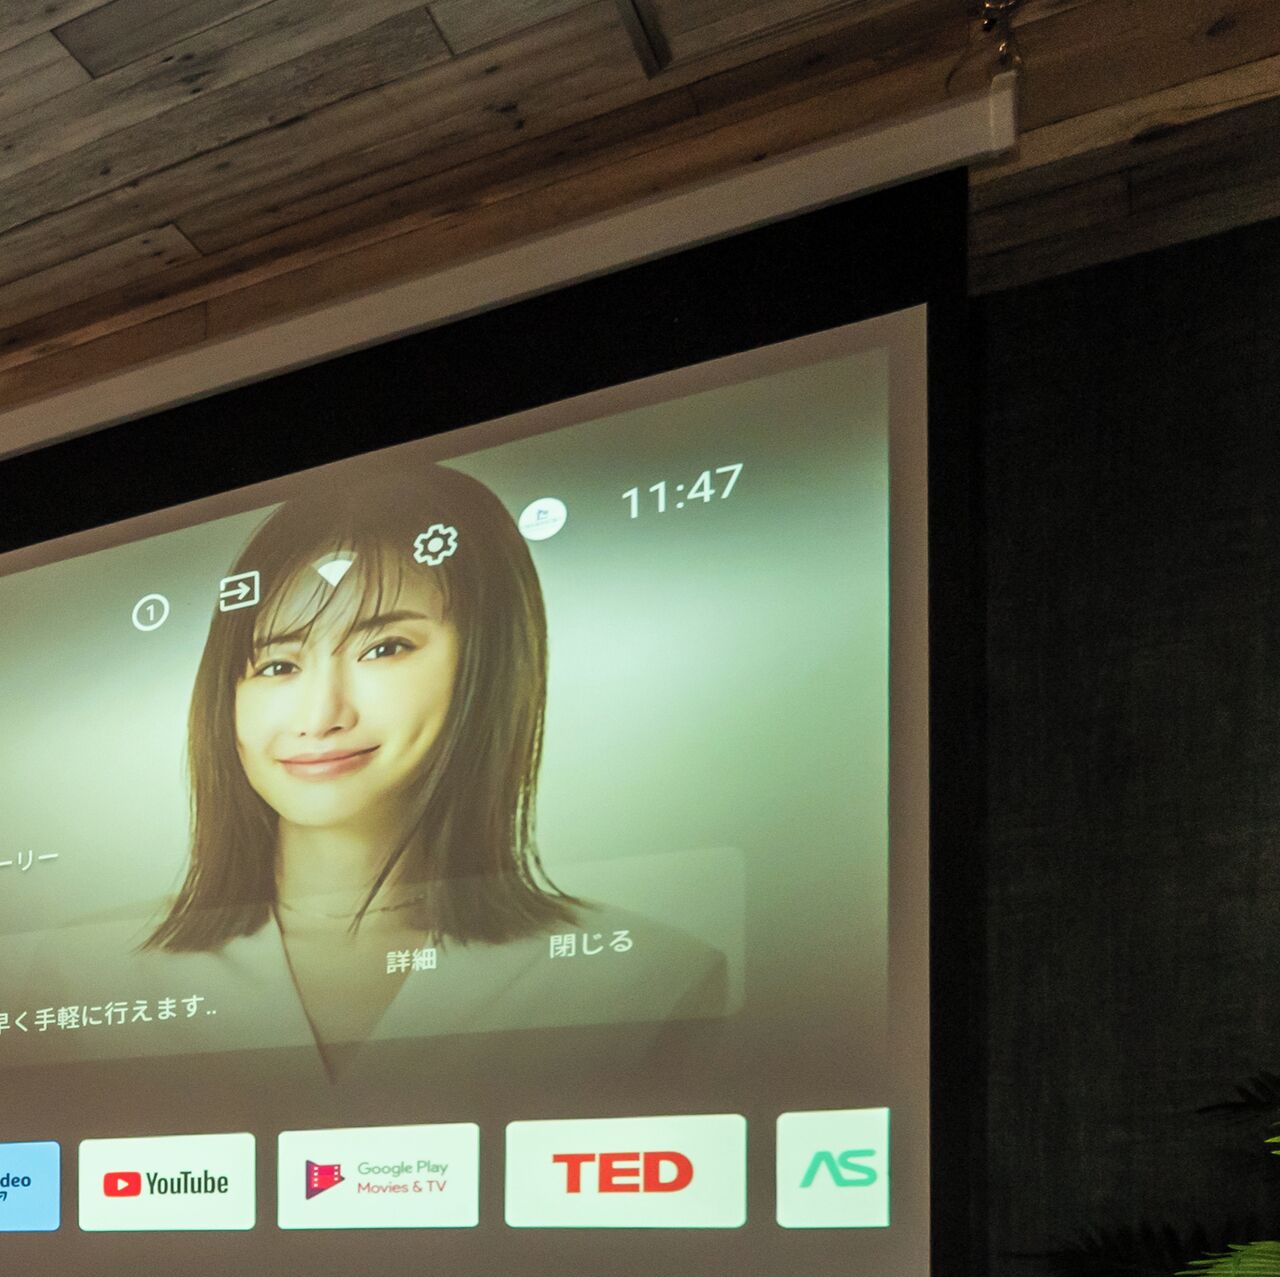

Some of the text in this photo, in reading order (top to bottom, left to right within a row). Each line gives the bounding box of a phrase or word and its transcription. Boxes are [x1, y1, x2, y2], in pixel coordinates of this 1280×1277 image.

[622, 462, 745, 520] 11:47
[548, 926, 634, 961] 閉じる
[385, 947, 439, 976] 詳細
[146, 1169, 229, 1196] YouTube
[357, 1159, 449, 1178] Google Play
[552, 1150, 695, 1194] TED
[357, 1180, 448, 1194] Movies & TV
